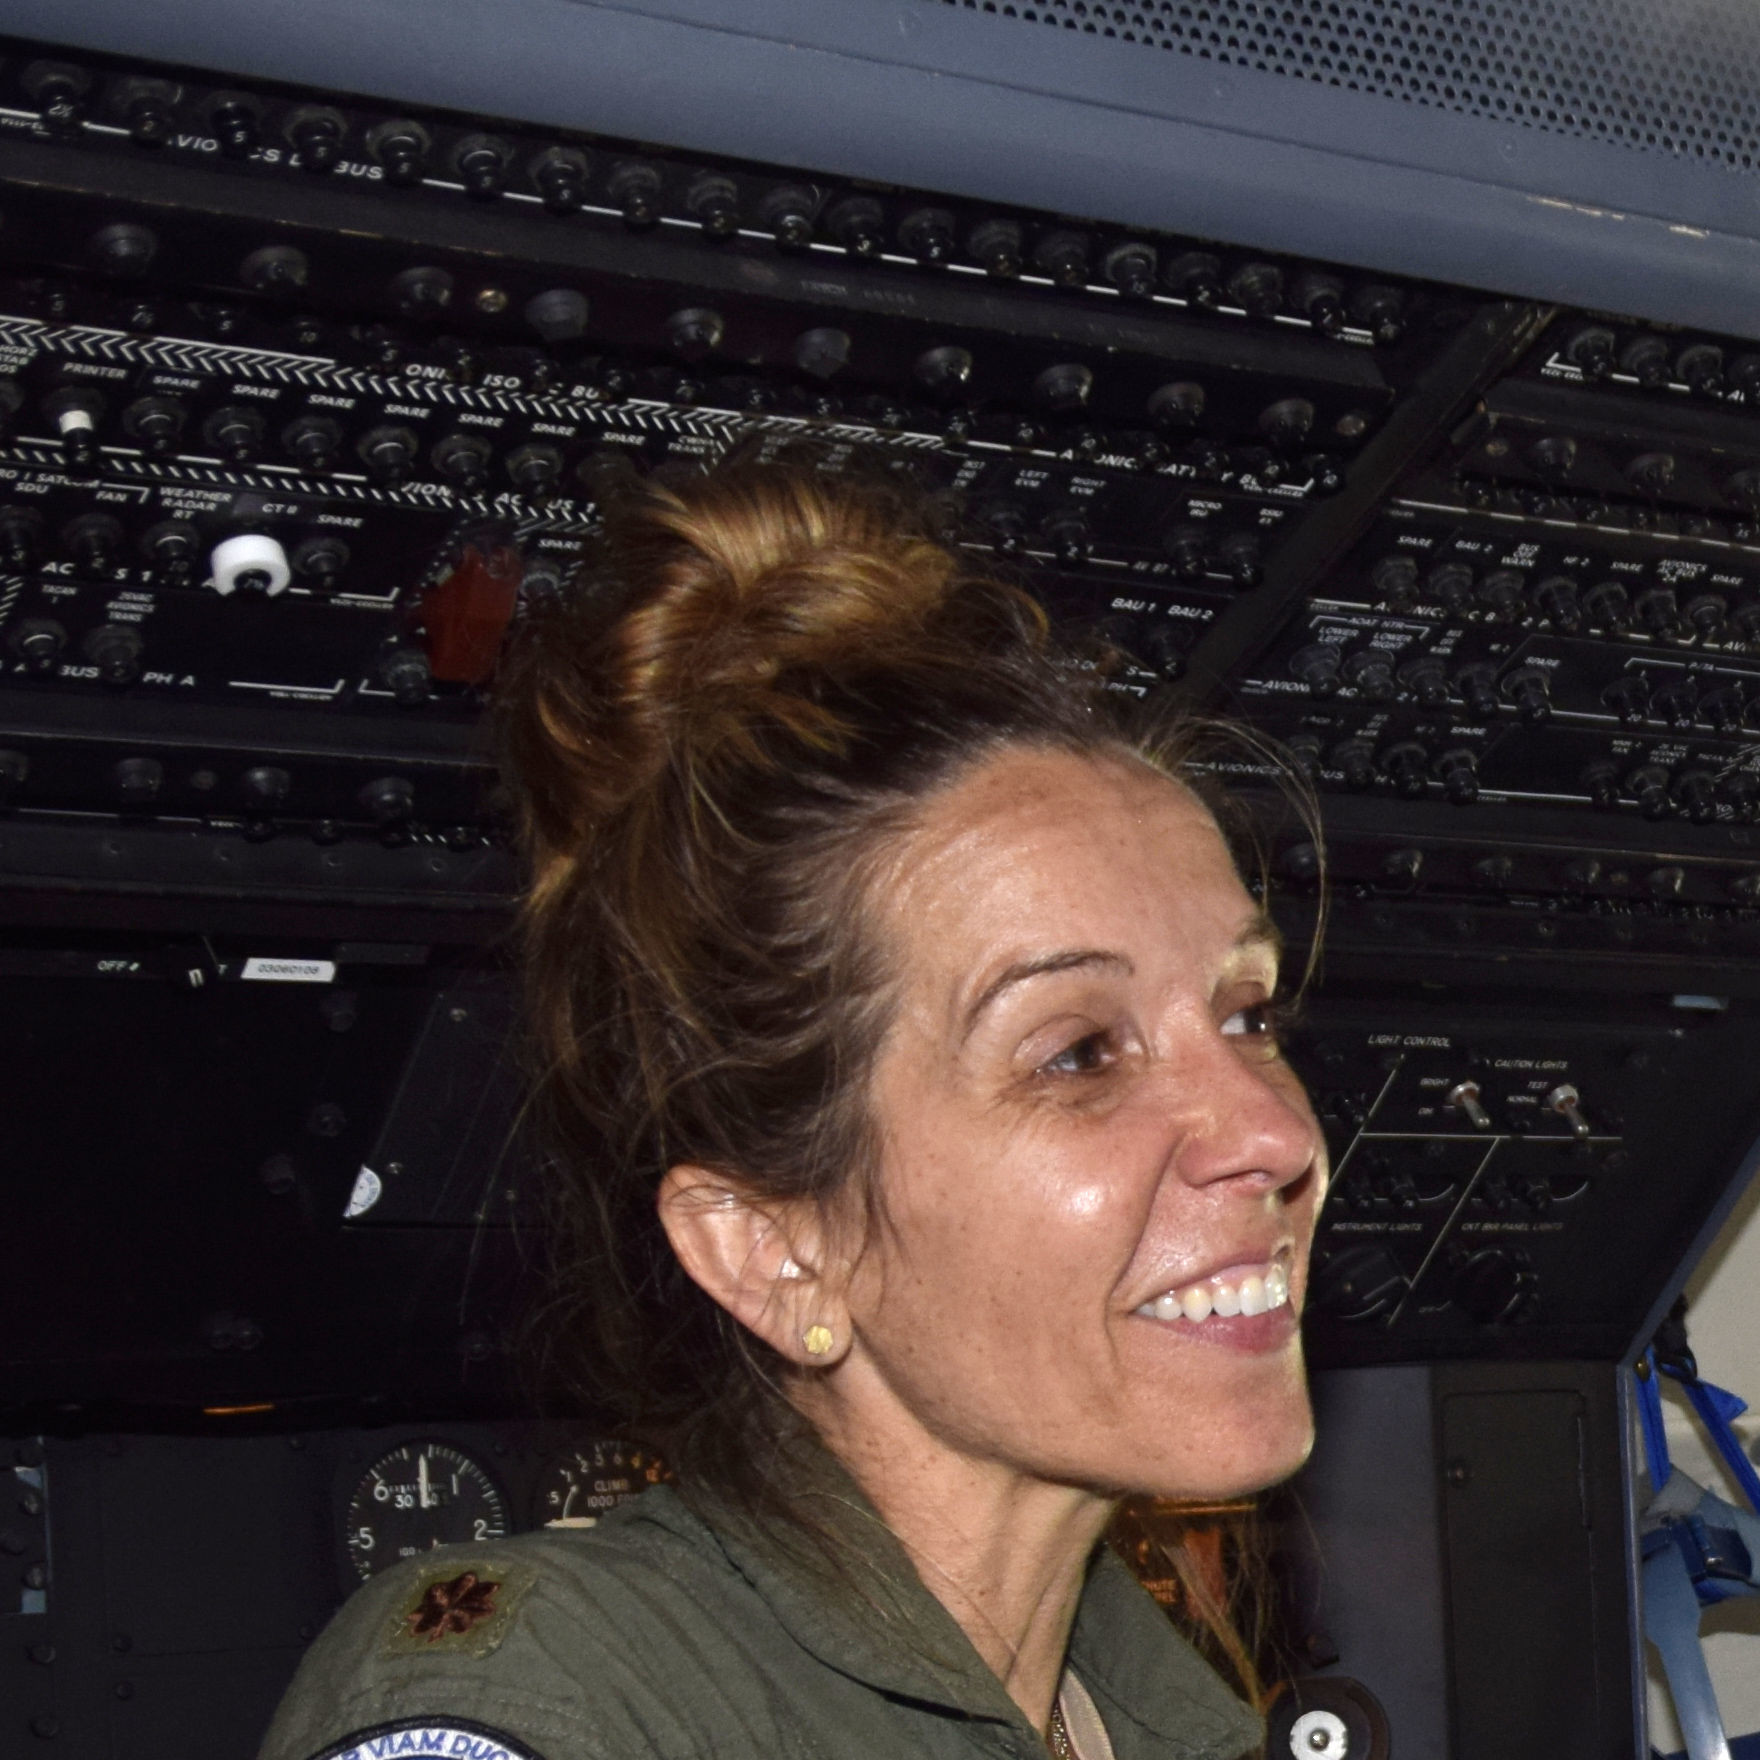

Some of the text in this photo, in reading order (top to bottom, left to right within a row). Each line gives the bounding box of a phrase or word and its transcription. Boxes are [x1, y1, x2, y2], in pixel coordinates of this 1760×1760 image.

[62, 361, 128, 381] PRINTER
[152, 375, 200, 390] SPARE
[481, 373, 522, 390] ISO
[231, 384, 281, 400] SPARE
[307, 393, 356, 410] SPARE
[383, 403, 432, 420] SPARE
[457, 412, 504, 429] SPARE
[531, 421, 577, 438] SPARE
[601, 430, 646, 447] SPARE
[14, 481, 50, 495] SDU
[158, 486, 233, 503] WEATHER
[95, 490, 128, 503] FAN
[160, 498, 218, 513] RADAR
[172, 508, 196, 520] RT
[316, 514, 364, 529] SPARE
[537, 536, 584, 552] SPARE
[1397, 535, 1433, 549] SPARE
[41, 560, 76, 576] AC
[1609, 560, 1644, 574] SPARE
[1709, 572, 1744, 586] SPARE
[1110, 597, 1146, 612] BAU
[1167, 604, 1202, 619] BAU
[1318, 626, 1360, 638] LOWER
[1525, 655, 1561, 668] SPARE
[142, 670, 175, 686] PH
[1450, 726, 1487, 737] SPARE
[1206, 761, 1283, 777] AVIONICS
[96, 959, 128, 972] OFF
[1368, 1033, 1452, 1048] LIGHT CONTROL
[1493, 1058, 1569, 1071] CAUTION LIGHTS
[1526, 1080, 1550, 1090] TEST
[373, 1478, 389, 1502] 6
[451, 1473, 460, 1496] 1
[473, 1518, 489, 1542] 2
[358, 1526, 376, 1551] 5
[367, 1730, 449, 1759] VIAM
